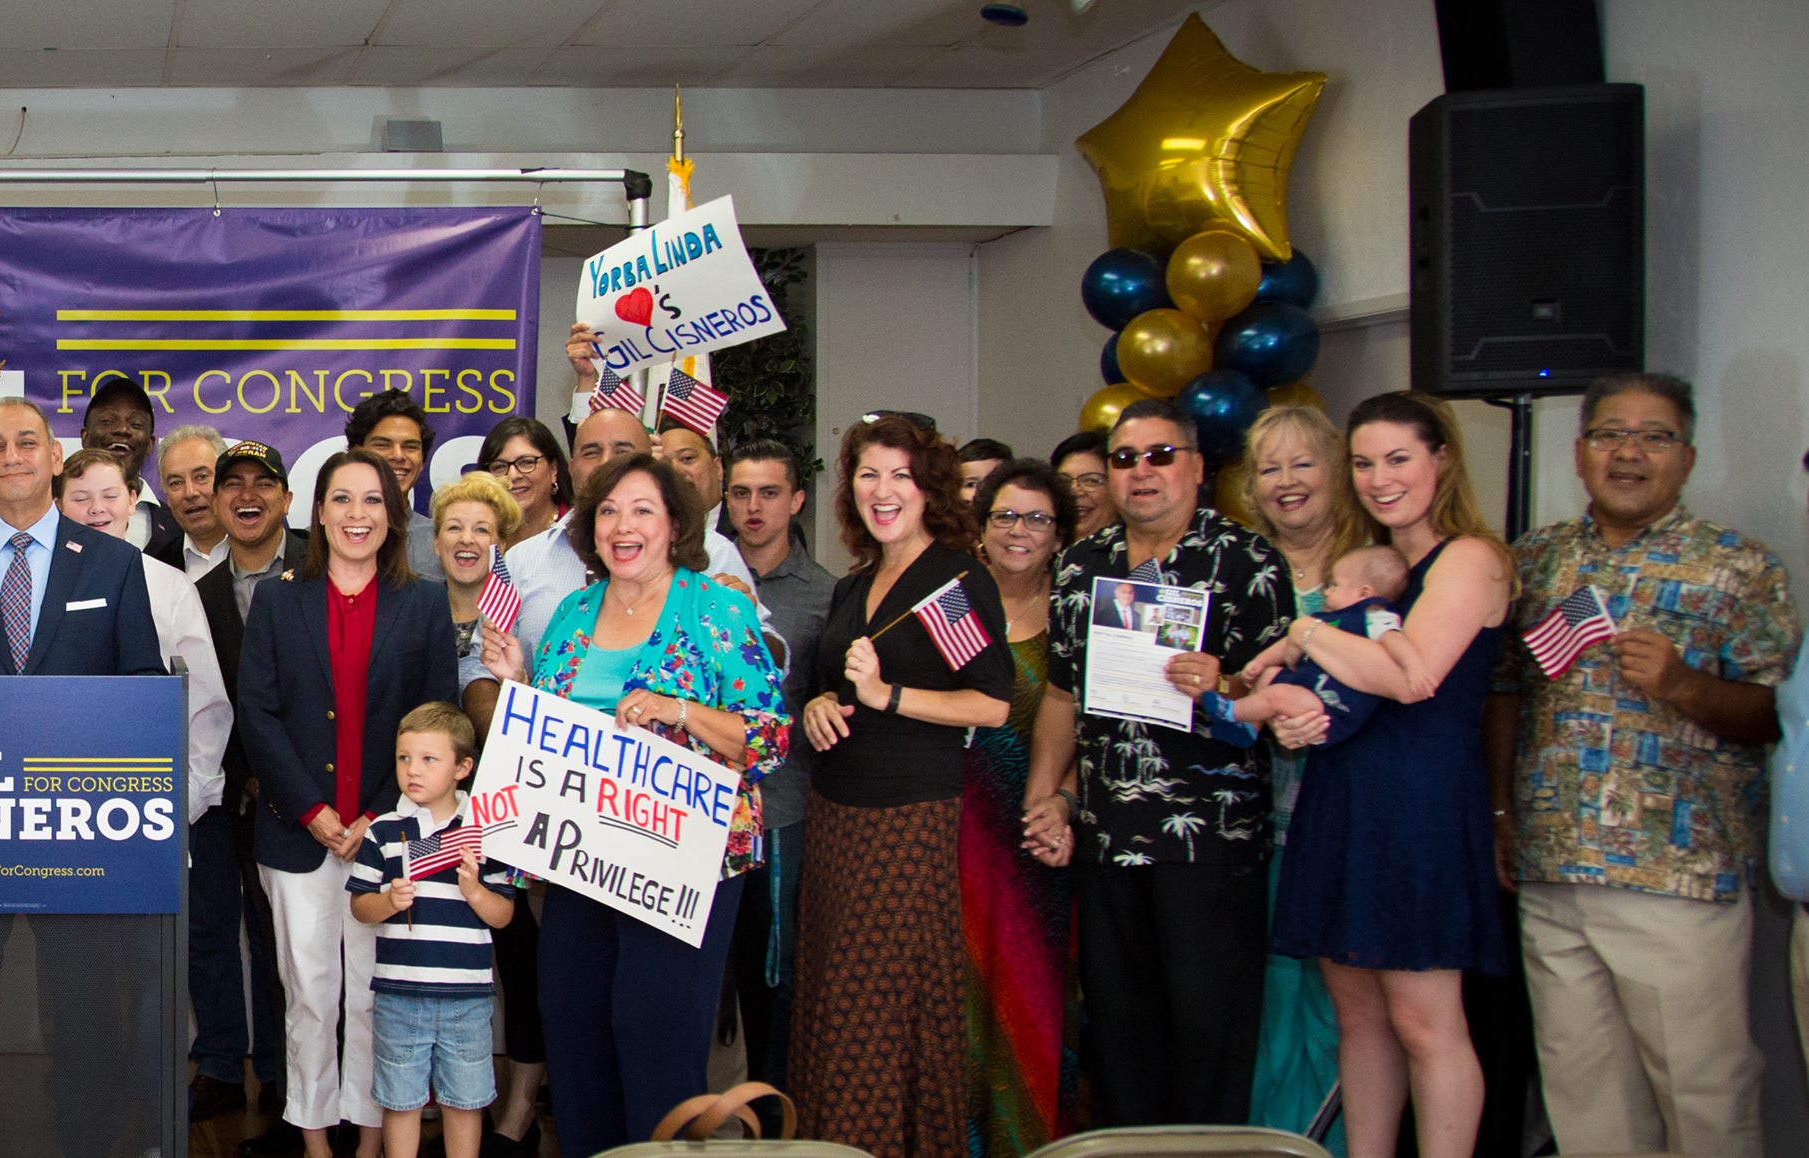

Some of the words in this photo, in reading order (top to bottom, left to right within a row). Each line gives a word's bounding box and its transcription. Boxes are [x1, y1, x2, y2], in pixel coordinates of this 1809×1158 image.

[590, 255, 652, 299] YORBA
[652, 223, 723, 276] LINDA
[591, 331, 653, 370] GIL
[645, 294, 773, 353] CISNEROS
[56, 370, 174, 414] FR
[23, 776, 62, 792] FOR
[67, 776, 173, 792] CONGRESS
[501, 687, 733, 827] HEALTHCARE
[515, 756, 546, 789] IS
[559, 769, 586, 803] A
[597, 778, 688, 842] RIGHT
[471, 784, 519, 828] NOT
[523, 811, 551, 849] A
[549, 819, 700, 929] PRIVILEGE!!!
